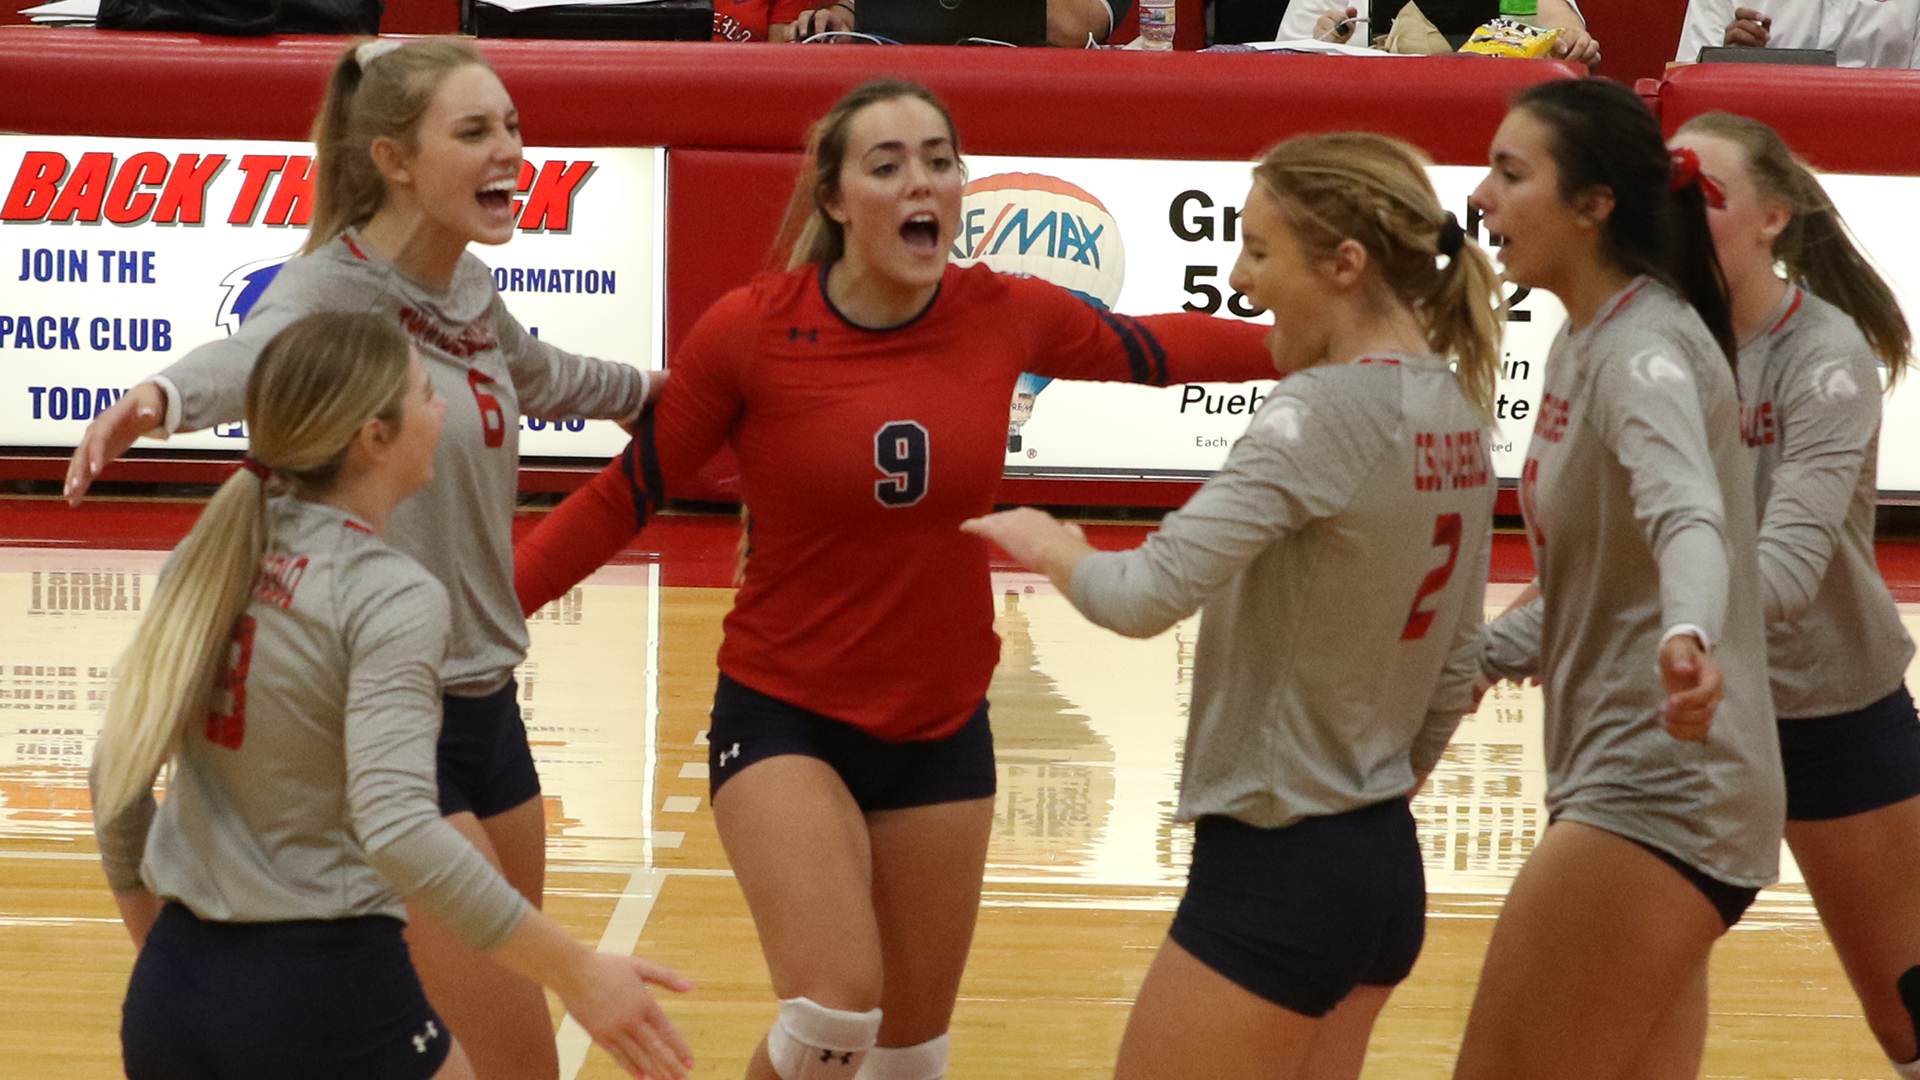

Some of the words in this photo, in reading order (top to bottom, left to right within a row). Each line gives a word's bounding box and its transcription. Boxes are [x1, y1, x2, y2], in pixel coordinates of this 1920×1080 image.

[0, 151, 231, 228] BACK
[19, 248, 88, 283] JOIN
[98, 250, 156, 283] THE
[488, 267, 616, 295] ORMATION
[0, 315, 80, 350] PACK
[89, 317, 172, 352] CLUB
[467, 368, 506, 449] 6
[873, 418, 931, 509] 9
[1195, 435, 1229, 448] Each
[1400, 512, 1462, 642] 2
